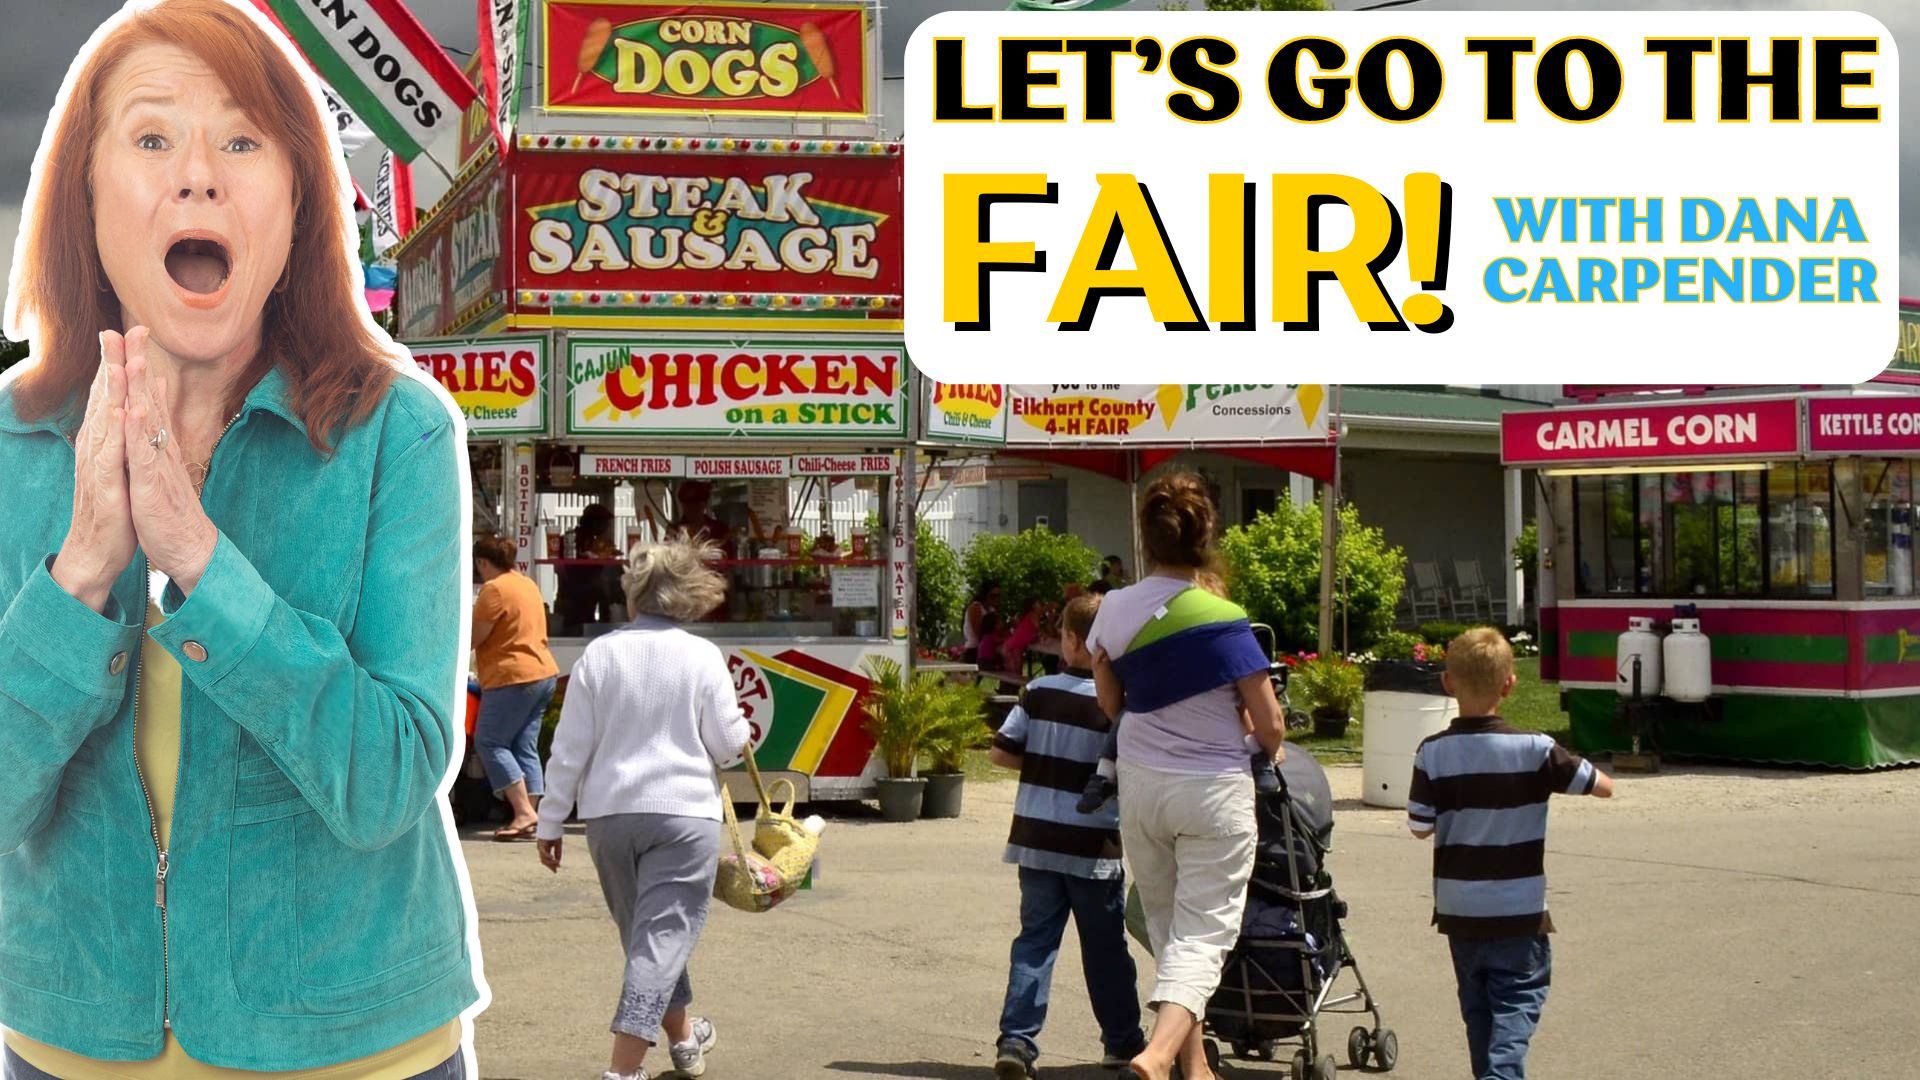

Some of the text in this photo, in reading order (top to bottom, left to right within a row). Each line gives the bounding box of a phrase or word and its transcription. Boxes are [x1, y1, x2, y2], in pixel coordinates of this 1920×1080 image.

[658, 19, 753, 46] CORN
[348, 25, 443, 128] DOGS
[612, 37, 799, 98] DOGS
[578, 168, 820, 226] STEAK
[692, 208, 728, 237] &
[528, 218, 880, 279] SAUSAGE
[574, 345, 631, 384] CAJUN
[604, 353, 898, 411] CHICKEN
[473, 406, 518, 420] Cheese
[725, 402, 897, 425] on a STICK
[1012, 397, 1156, 420] Elkhart County
[1212, 404, 1292, 416] Concessions
[1045, 418, 1130, 435] 4-H FAIR
[1536, 412, 1758, 451] CARMEL CORN
[1820, 413, 1883, 436] KETTLE
[595, 457, 673, 473] FRENCH FRIES
[694, 459, 783, 475] POLISH SAUSAGE
[797, 456, 891, 472] Chili-Cheese FRIES
[519, 464, 530, 548] BOTTLED
